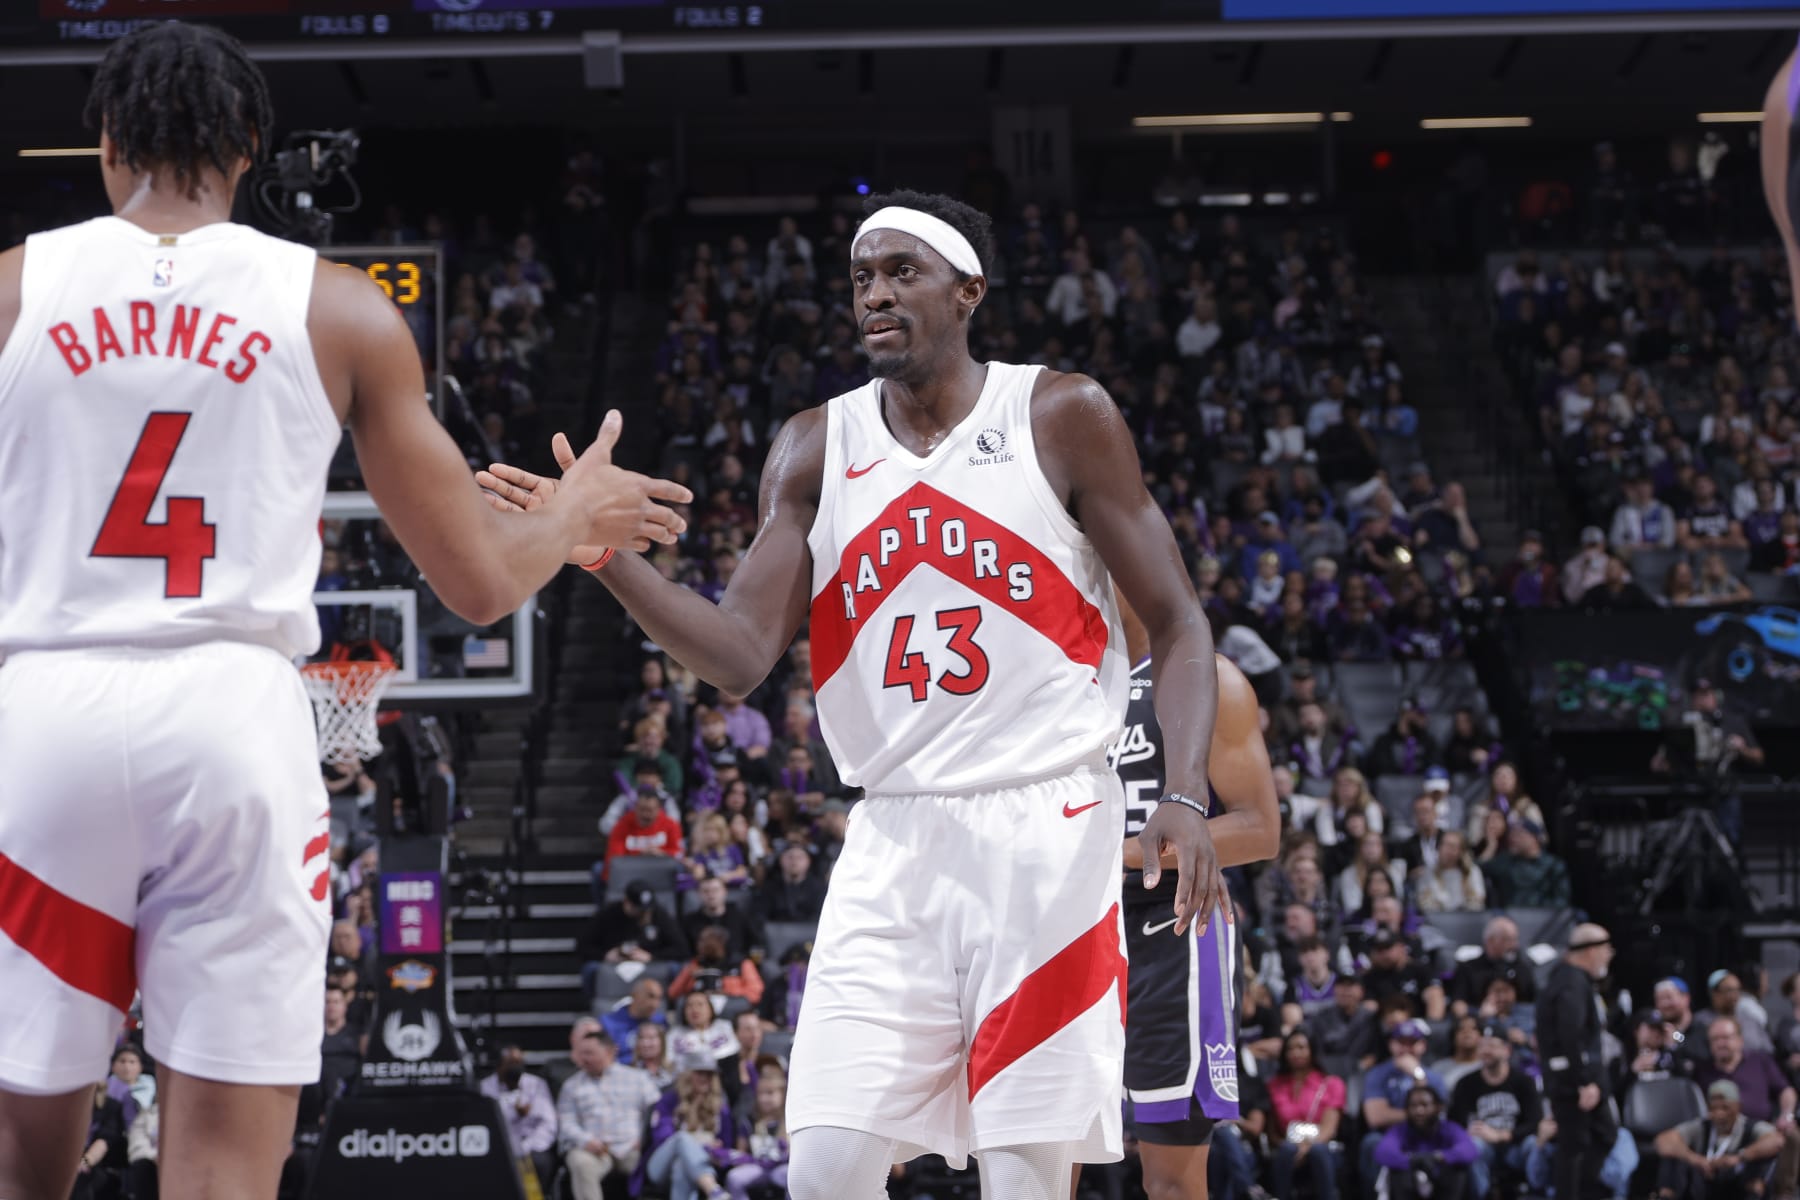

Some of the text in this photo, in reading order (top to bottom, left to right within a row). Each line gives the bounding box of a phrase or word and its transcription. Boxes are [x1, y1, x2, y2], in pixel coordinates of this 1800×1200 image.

[301, 15, 366, 35] FOULS
[432, 10, 555, 32] TIMEOUTS 7
[673, 6, 763, 27] FOULS 2
[48, 300, 272, 384] BARNES
[968, 452, 1015, 467] Sun Life
[88, 411, 216, 599] 4
[841, 506, 1034, 620] RAPTORS
[883, 605, 990, 702] 43
[1125, 780, 1160, 832] 5
[361, 1061, 463, 1078] REDHAWK
[338, 1127, 457, 1163] dialpad
